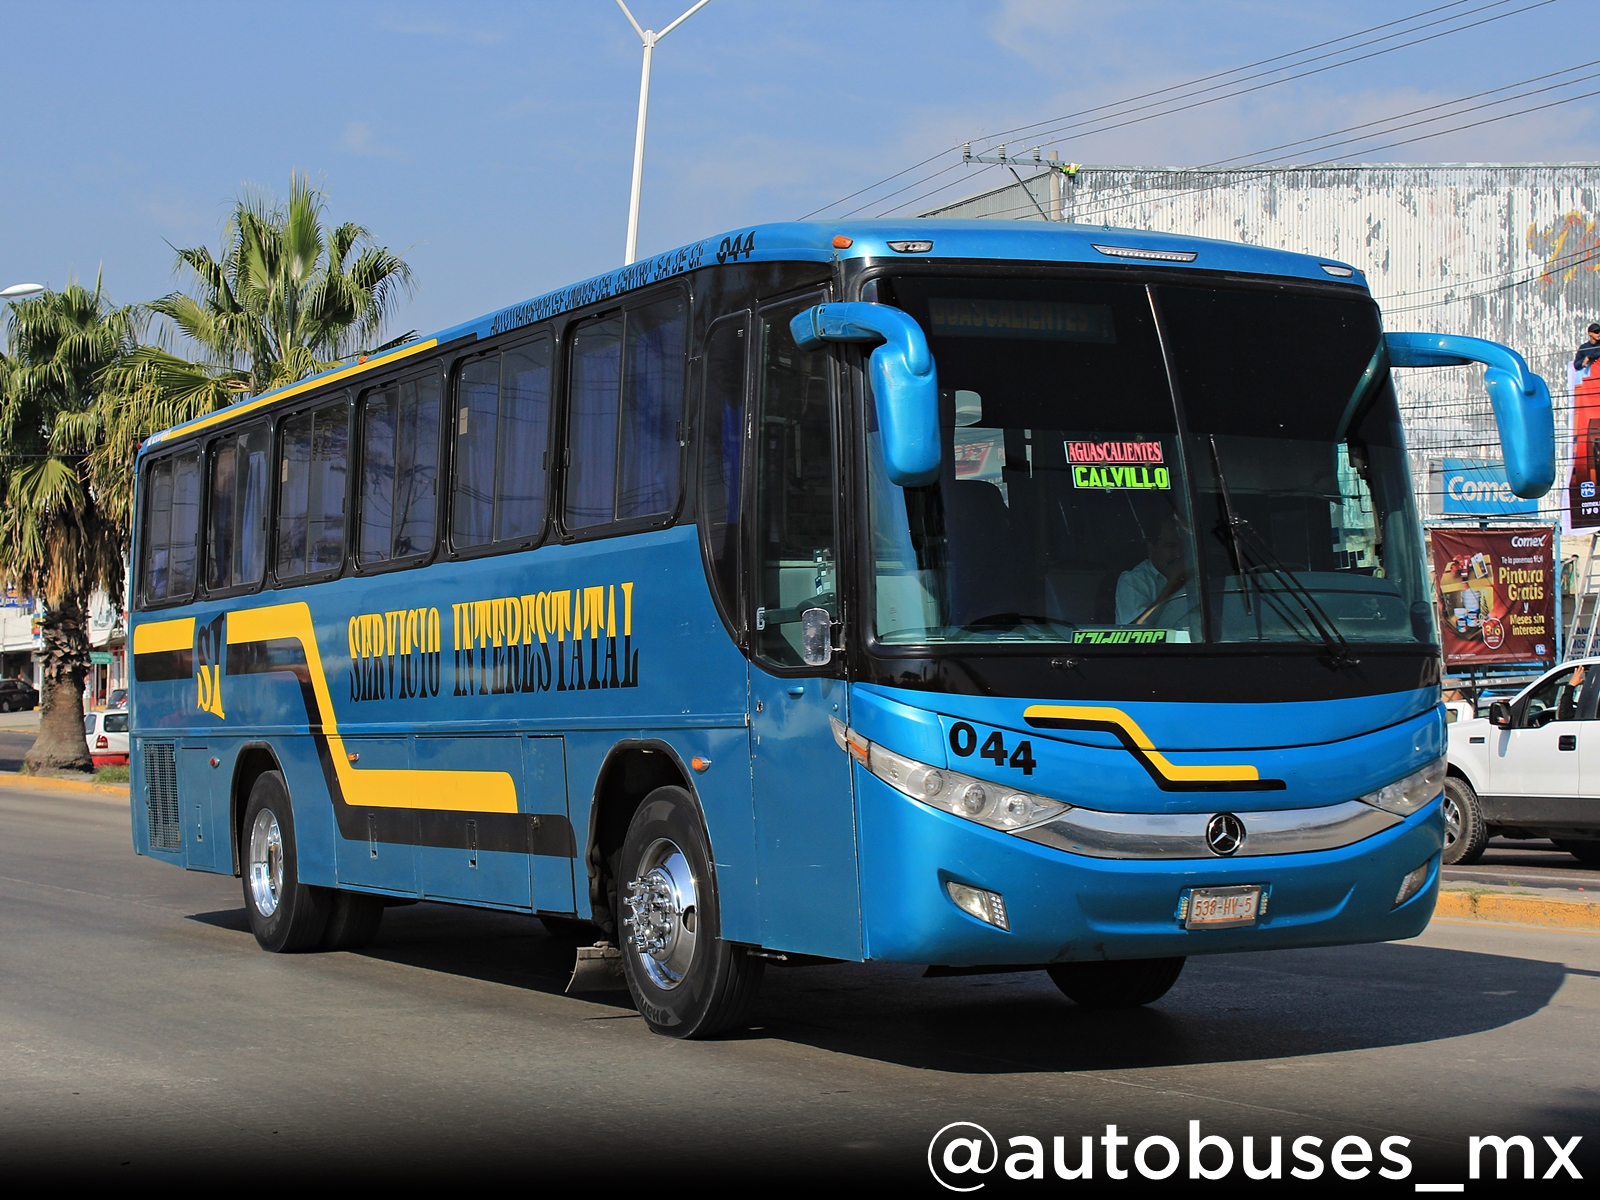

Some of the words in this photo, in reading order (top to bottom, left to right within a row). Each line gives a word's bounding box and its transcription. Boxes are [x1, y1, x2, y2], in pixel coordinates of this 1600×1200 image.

[716, 230, 756, 264] 044
[595, 273, 614, 300] DEL
[614, 259, 653, 293] CENTRO
[1068, 442, 1162, 462] AGUASCALIENTES
[1074, 467, 1168, 488] CALVILLO
[1511, 534, 1547, 548] Comex
[1499, 567, 1543, 585] Pintura
[1508, 584, 1544, 601] Gratis
[1523, 602, 1529, 613] y
[1510, 614, 1532, 625] Meses
[1533, 614, 1545, 624] sin
[1512, 625, 1546, 636] intereses
[347, 606, 441, 702] SERVICIO
[452, 581, 639, 698] INTERESTATAL
[949, 721, 1037, 776] 044
